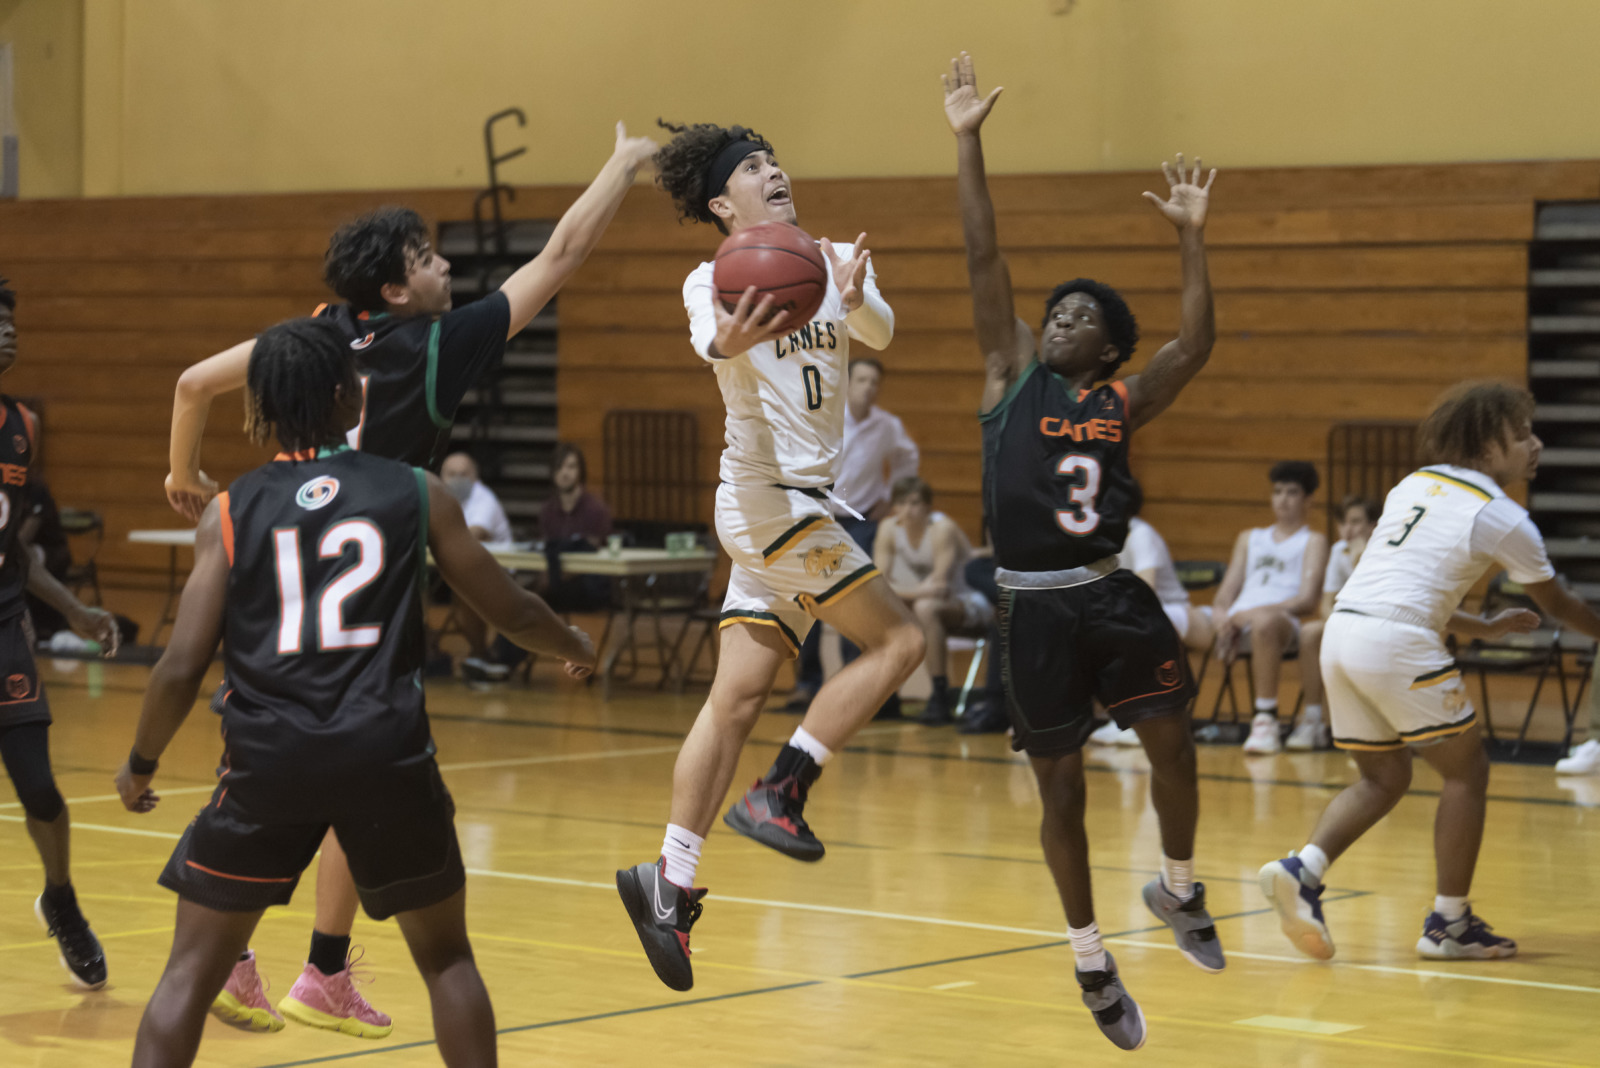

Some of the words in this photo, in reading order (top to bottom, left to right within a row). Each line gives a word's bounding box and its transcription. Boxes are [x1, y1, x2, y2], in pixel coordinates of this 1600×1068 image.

[776, 321, 837, 359] CANES
[802, 364, 823, 411] 0
[1040, 416, 1122, 442] CANES
[1055, 452, 1101, 537] 3
[1386, 504, 1427, 548] 3
[272, 516, 385, 655] 12
